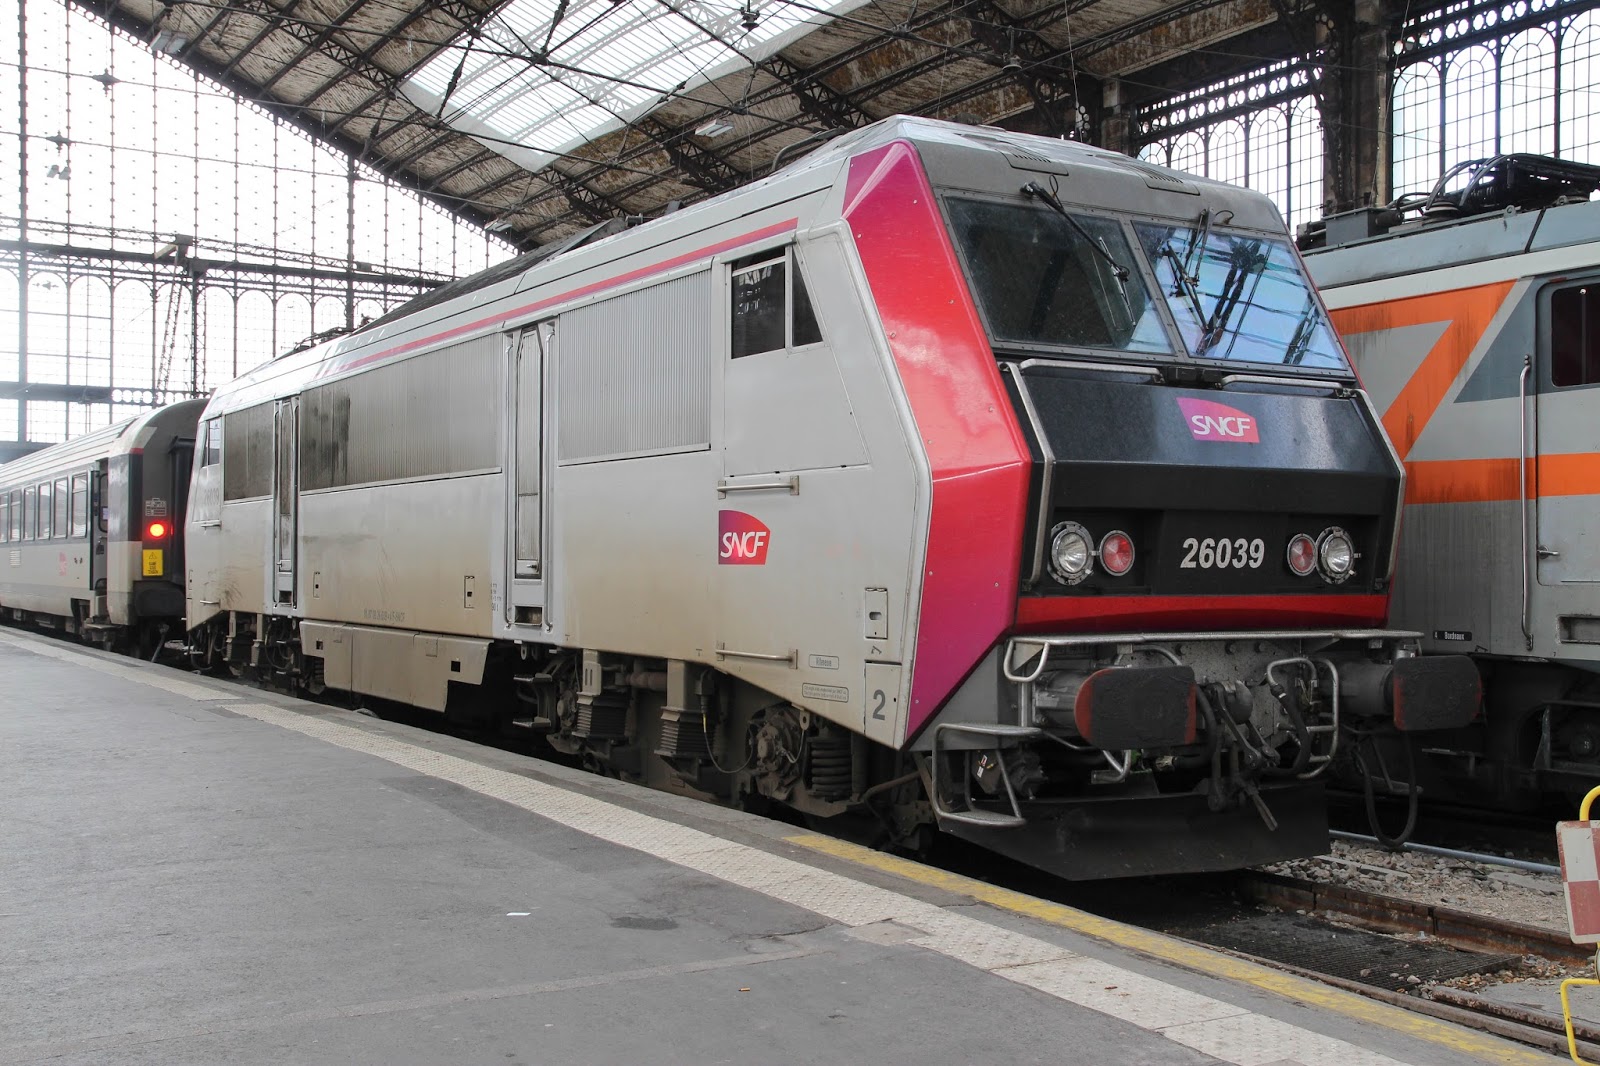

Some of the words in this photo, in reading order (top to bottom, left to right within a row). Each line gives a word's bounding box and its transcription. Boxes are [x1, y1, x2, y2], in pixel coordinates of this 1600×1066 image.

[1191, 414, 1251, 437] SNCF
[720, 531, 767, 558] SNCF
[1180, 537, 1265, 569] 26039
[1444, 631, 1465, 641] Bordeaux
[872, 689, 886, 721] 2
